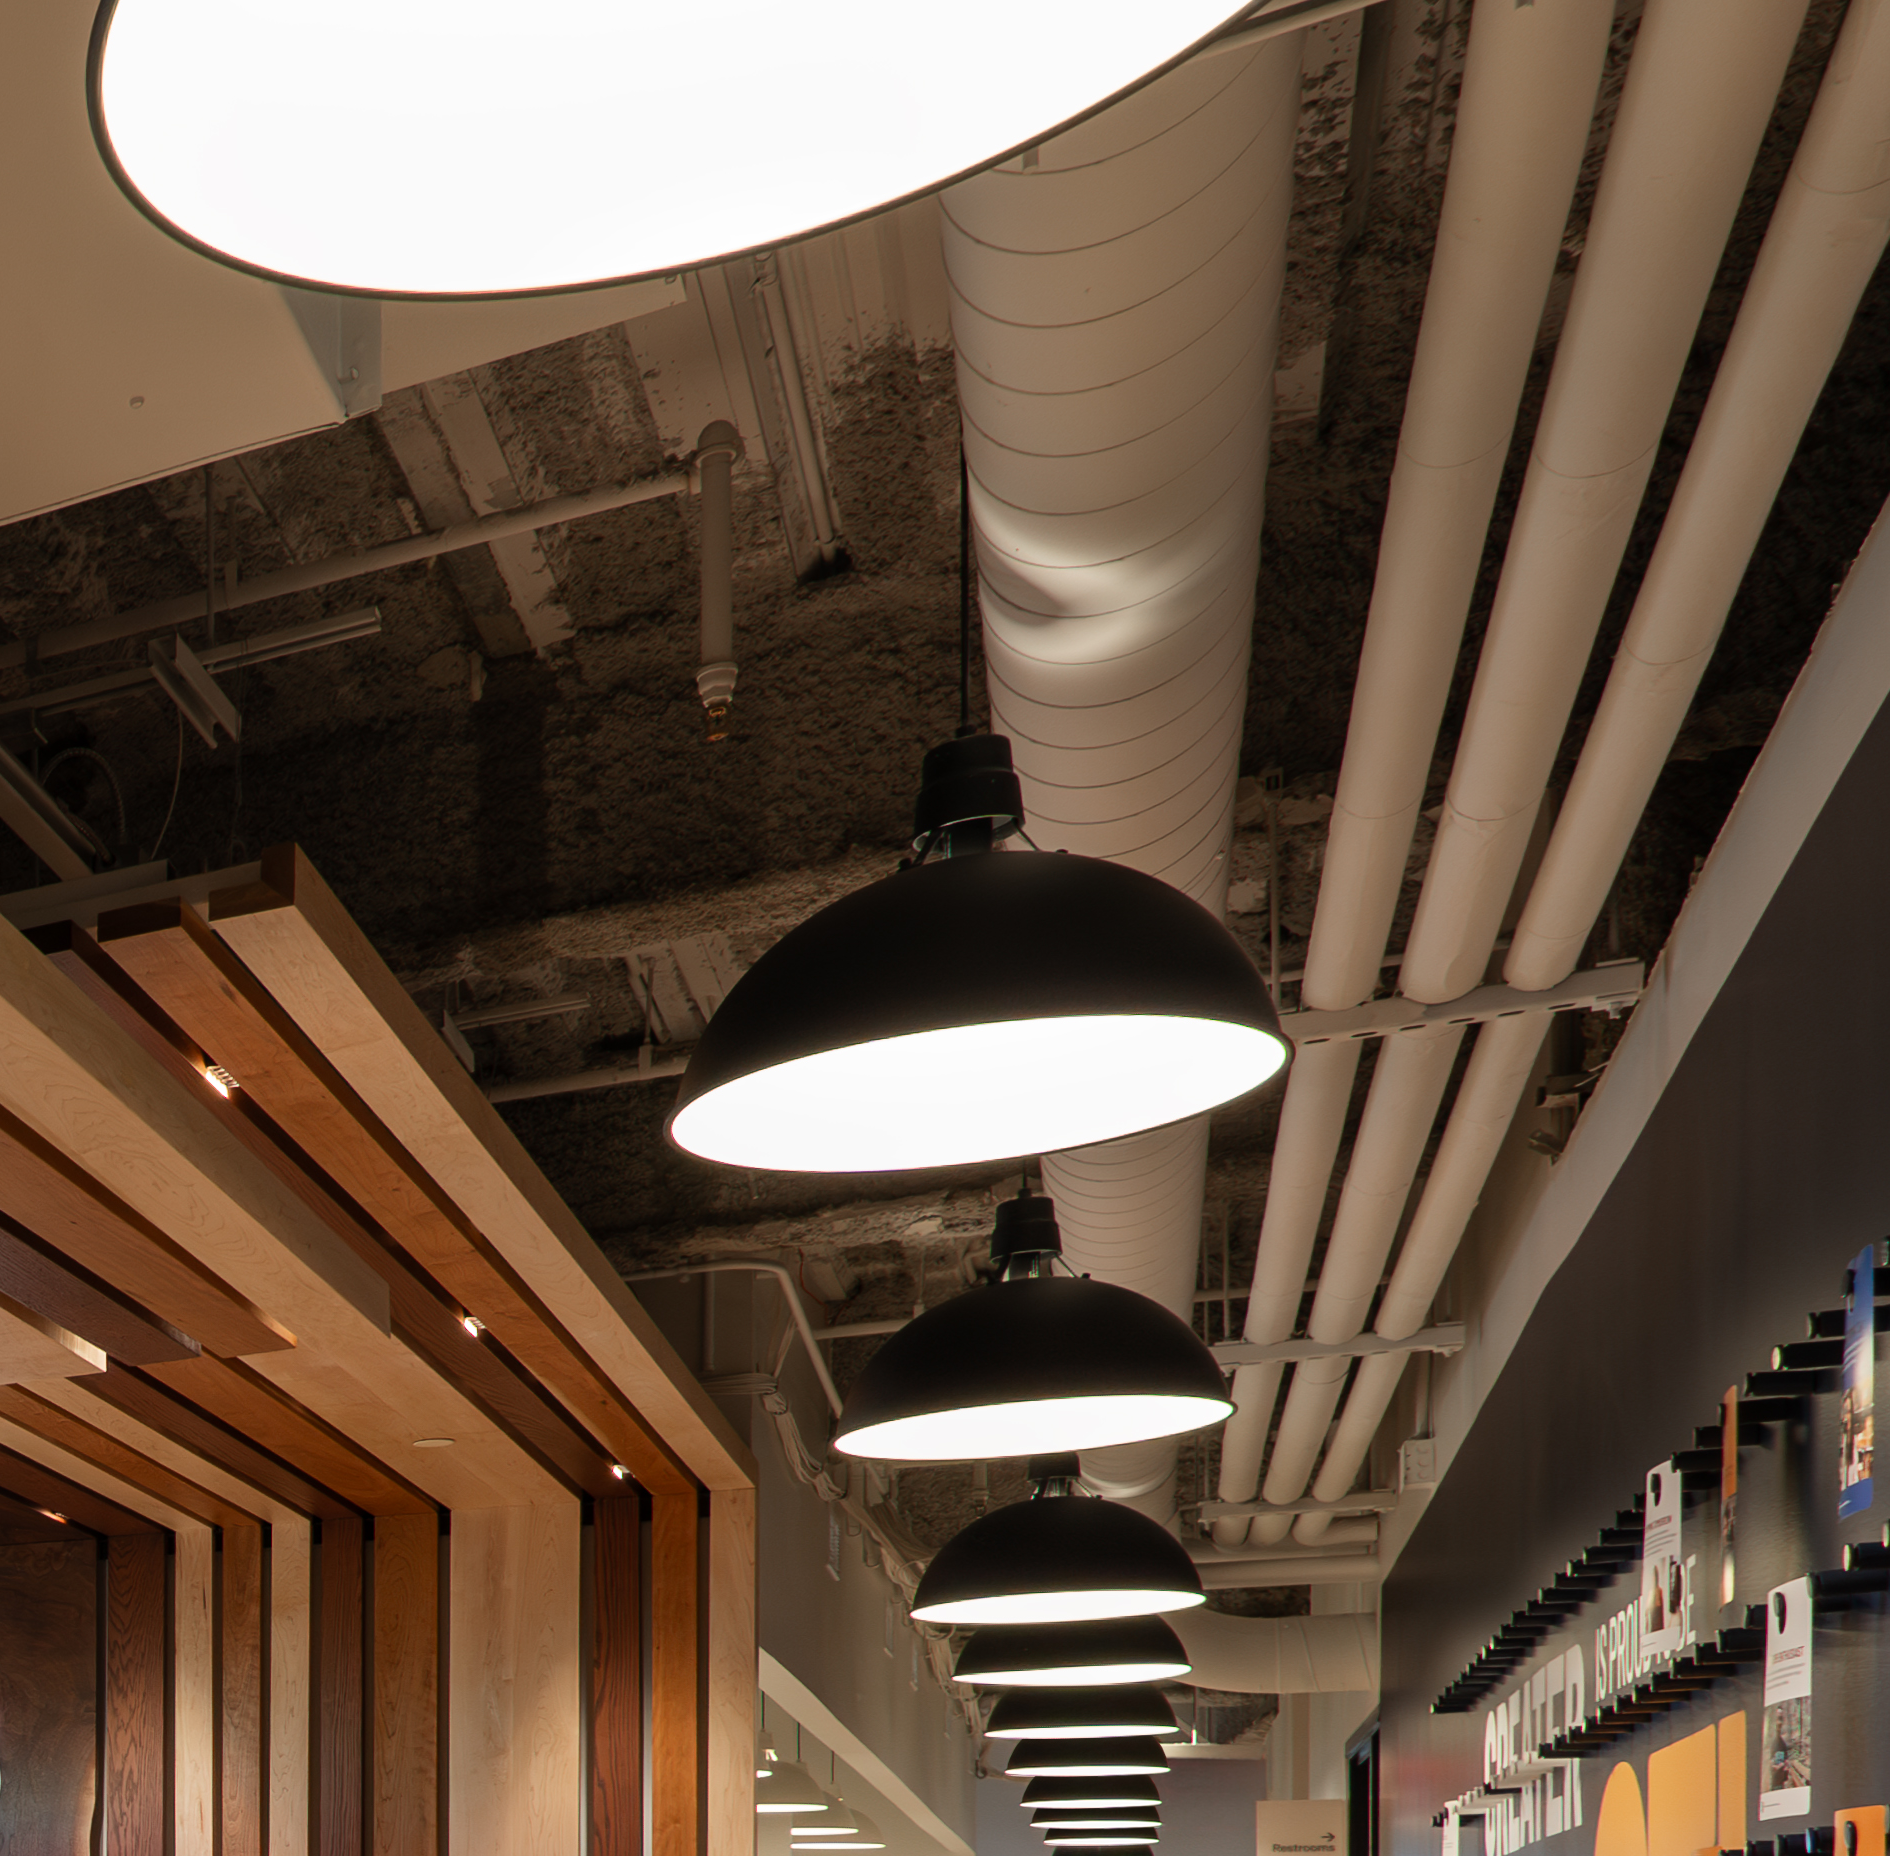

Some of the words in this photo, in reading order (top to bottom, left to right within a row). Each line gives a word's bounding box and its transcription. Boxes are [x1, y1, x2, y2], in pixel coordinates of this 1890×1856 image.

[1595, 1623, 1607, 1703] IS
[1608, 1594, 1652, 1694] PROU
[1272, 1843, 1336, 1853] Restrooms
